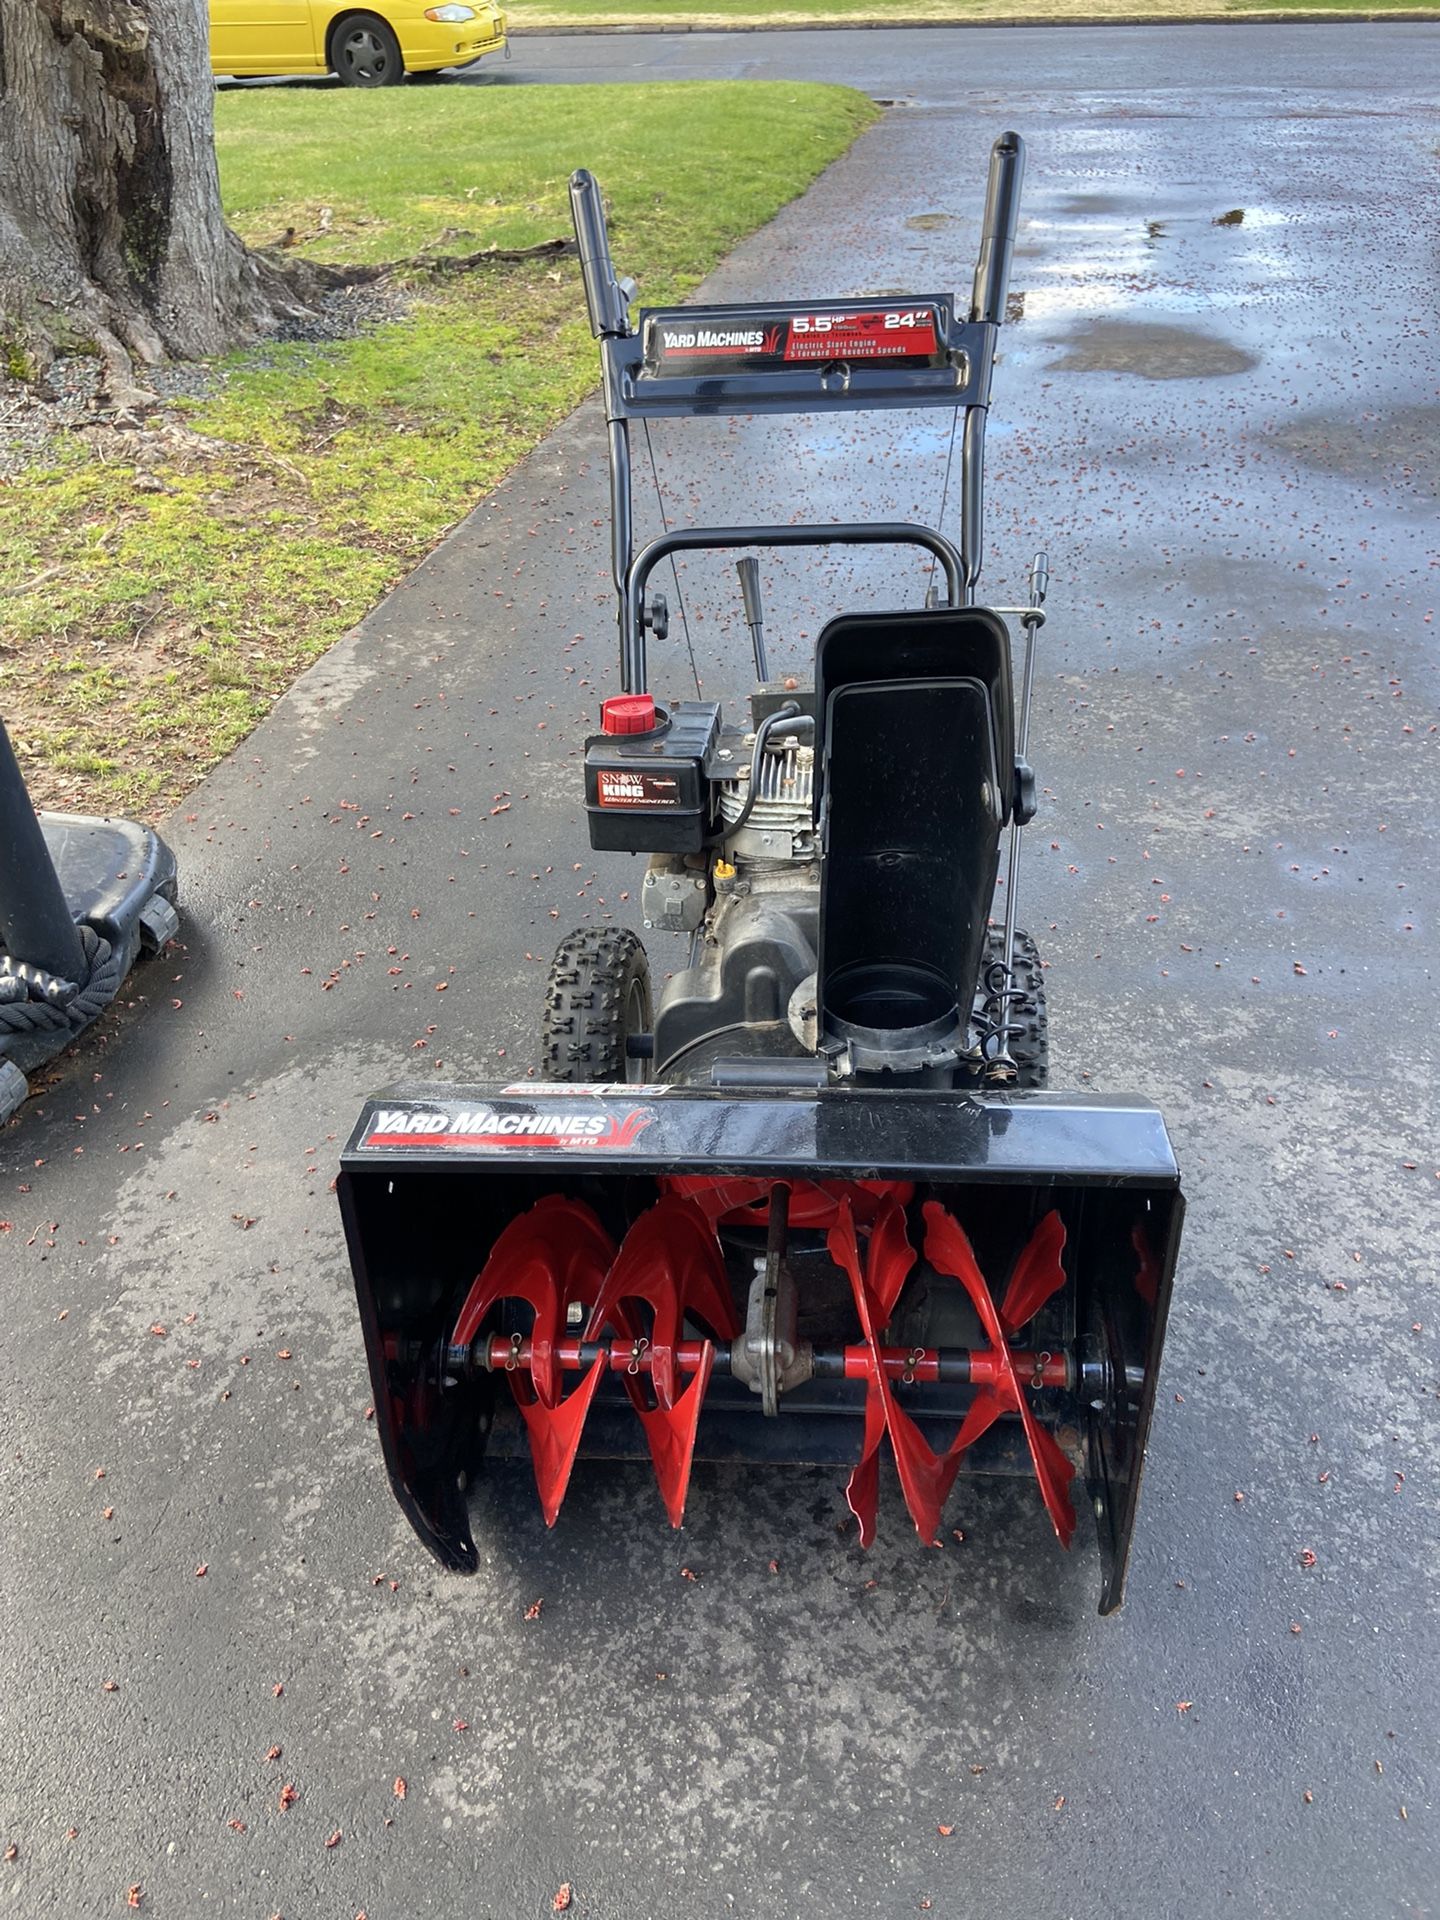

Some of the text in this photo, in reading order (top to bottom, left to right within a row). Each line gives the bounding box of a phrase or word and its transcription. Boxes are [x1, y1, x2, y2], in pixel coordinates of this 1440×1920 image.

[663, 330, 764, 348] YARD MACHINES
[792, 339, 877, 350] Electric Start Engine
[842, 347, 874, 356] Reverse
[877, 345, 907, 354] Speeds
[602, 784, 644, 797] KING
[374, 1110, 608, 1135] YARD MACHINES
[559, 1137, 598, 1146] by MTD
